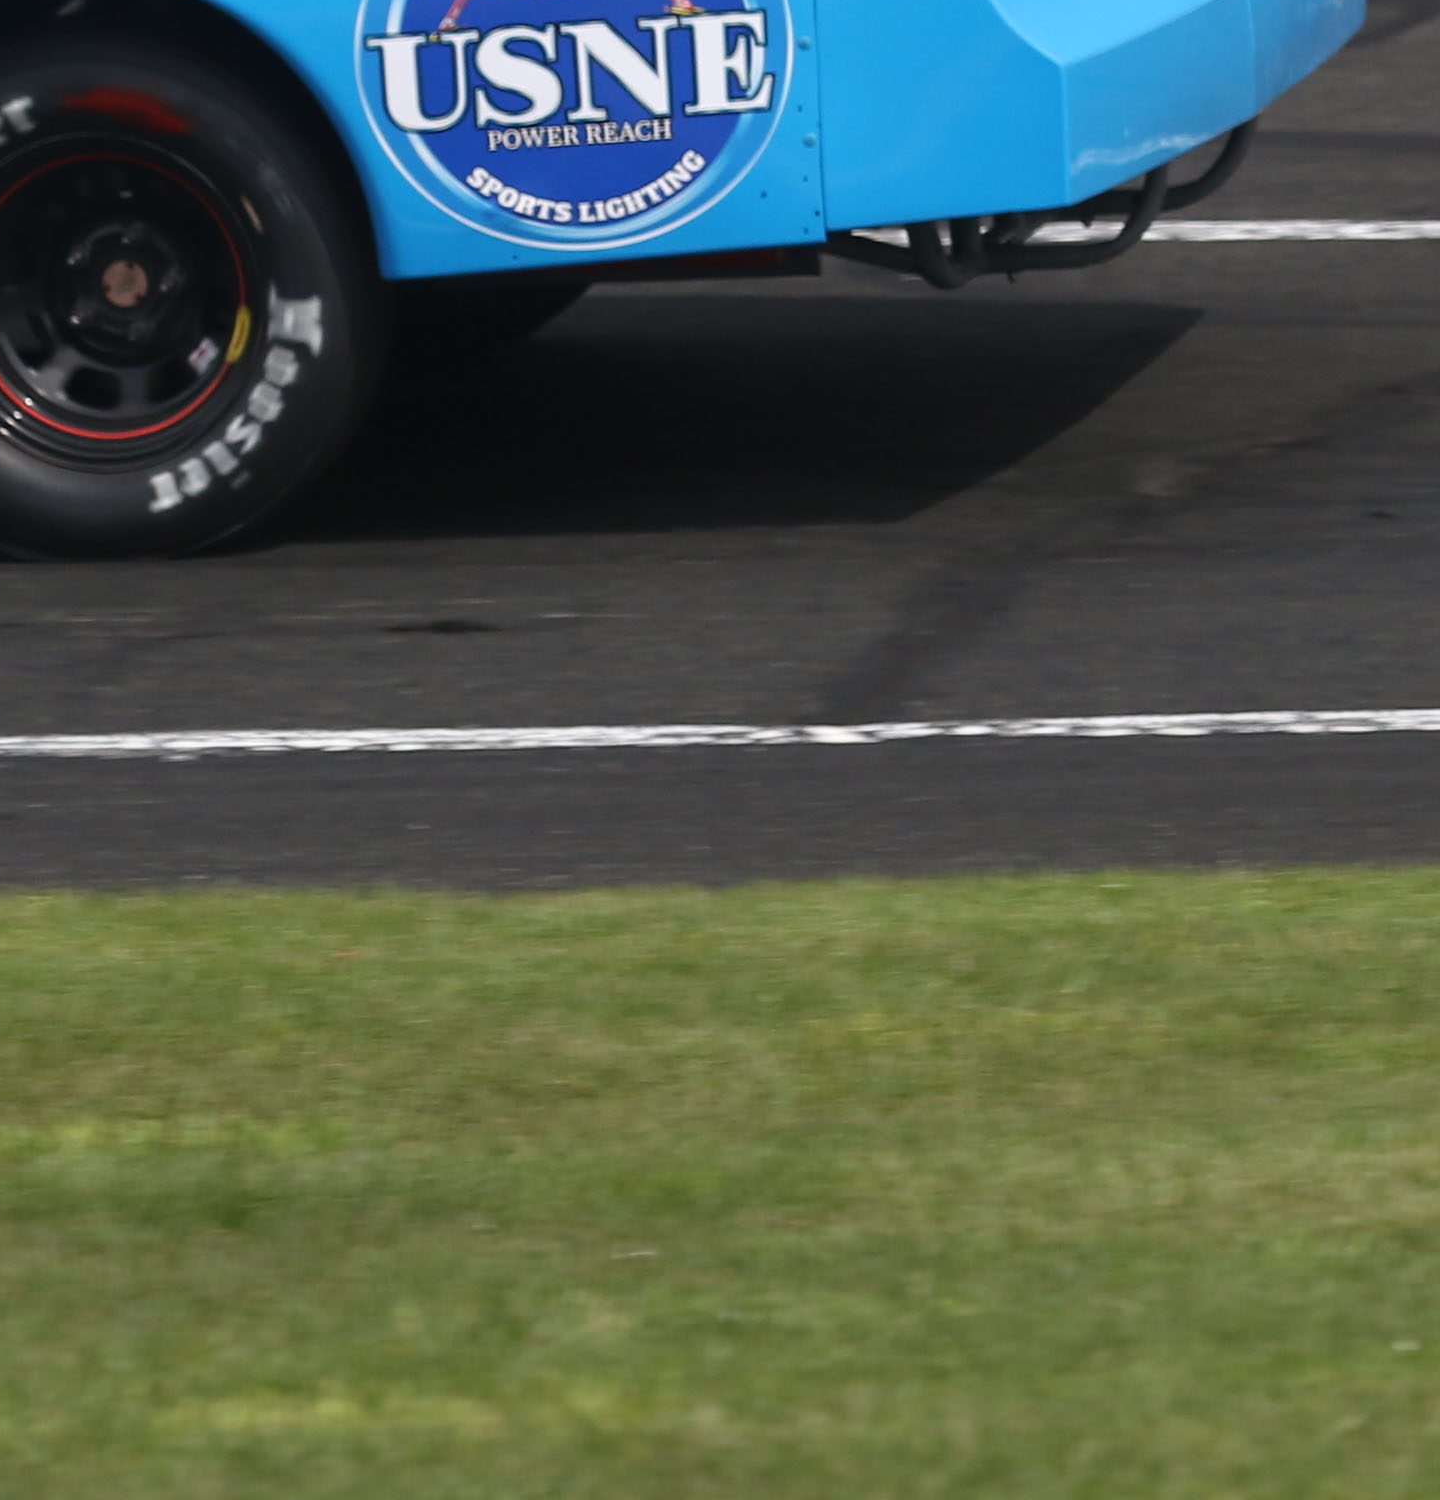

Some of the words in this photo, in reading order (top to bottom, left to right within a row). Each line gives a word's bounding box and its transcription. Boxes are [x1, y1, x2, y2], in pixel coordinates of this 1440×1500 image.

[366, 9, 775, 132] USNE
[487, 125, 581, 152] POWER
[586, 117, 673, 144] REACH
[466, 167, 572, 224] SPORTS
[578, 148, 706, 224] LIGHTING
